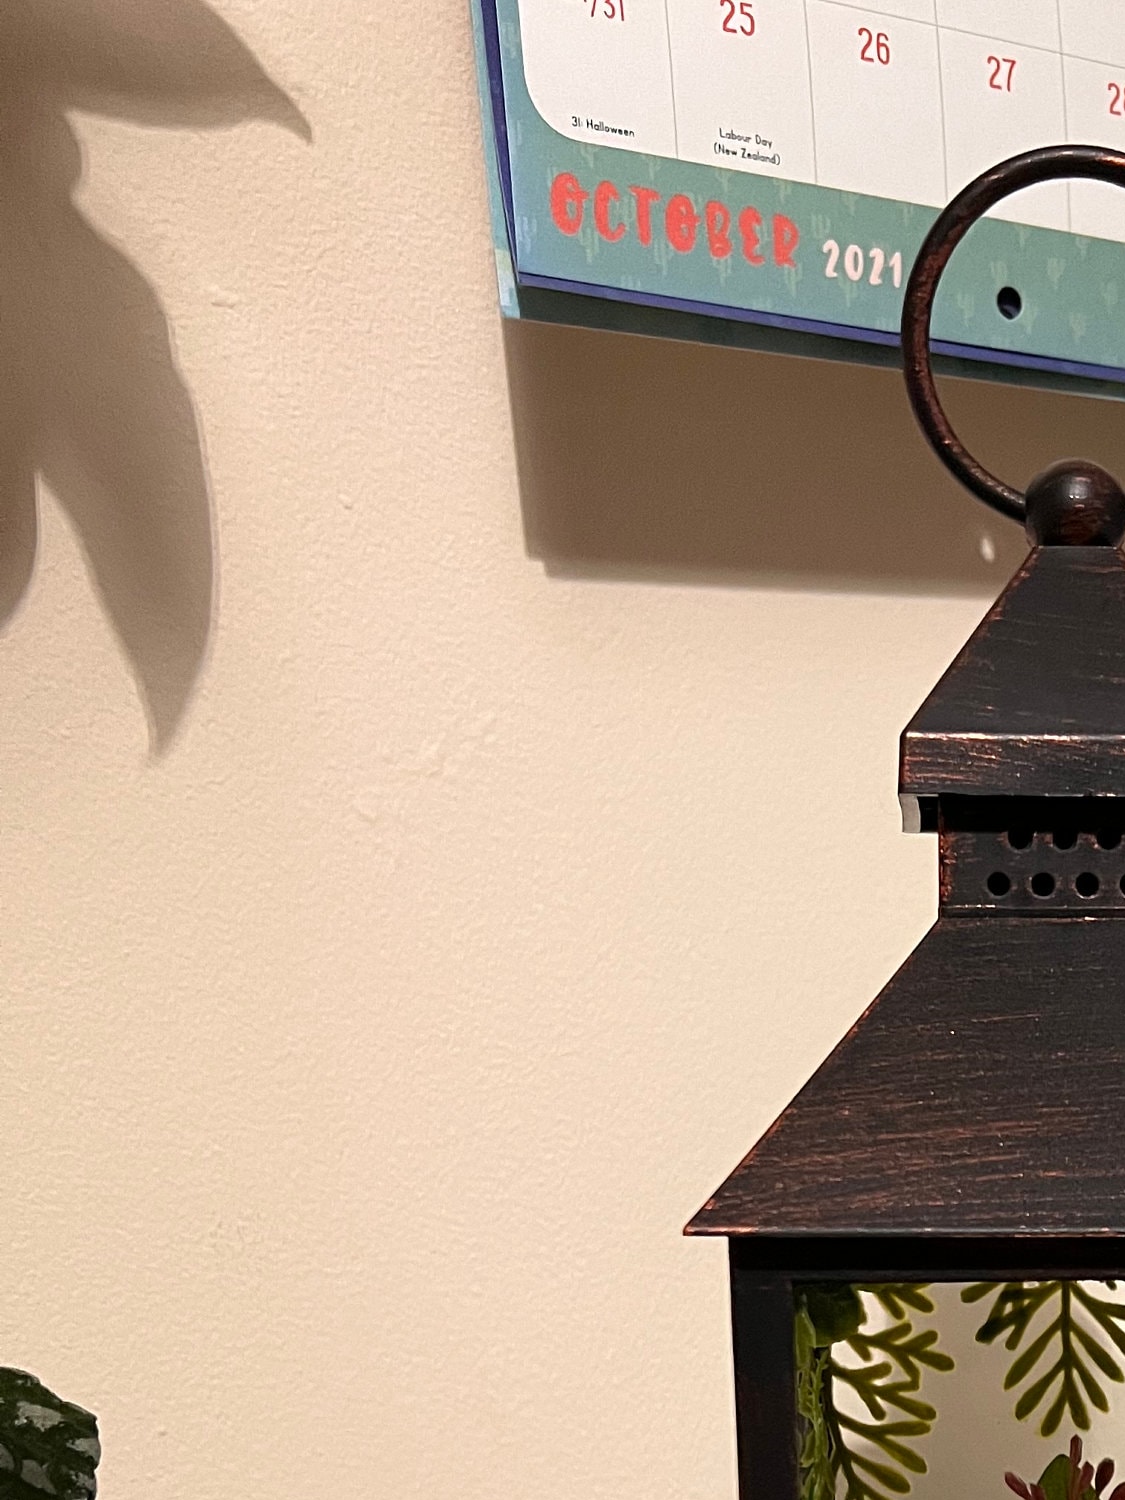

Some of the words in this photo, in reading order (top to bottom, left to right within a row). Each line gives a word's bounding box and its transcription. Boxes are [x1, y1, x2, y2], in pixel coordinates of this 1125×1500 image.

[720, 0, 756, 37] 25
[857, 27, 891, 65] 26
[987, 55, 1016, 92] 27
[586, 119, 635, 138] Halloween
[719, 127, 752, 143] Labour
[755, 134, 773, 149] Day
[713, 142, 737, 156] (New
[741, 148, 781, 166] Zealand)
[549, 170, 800, 269] OCTOBER
[822, 238, 902, 289] 2021
